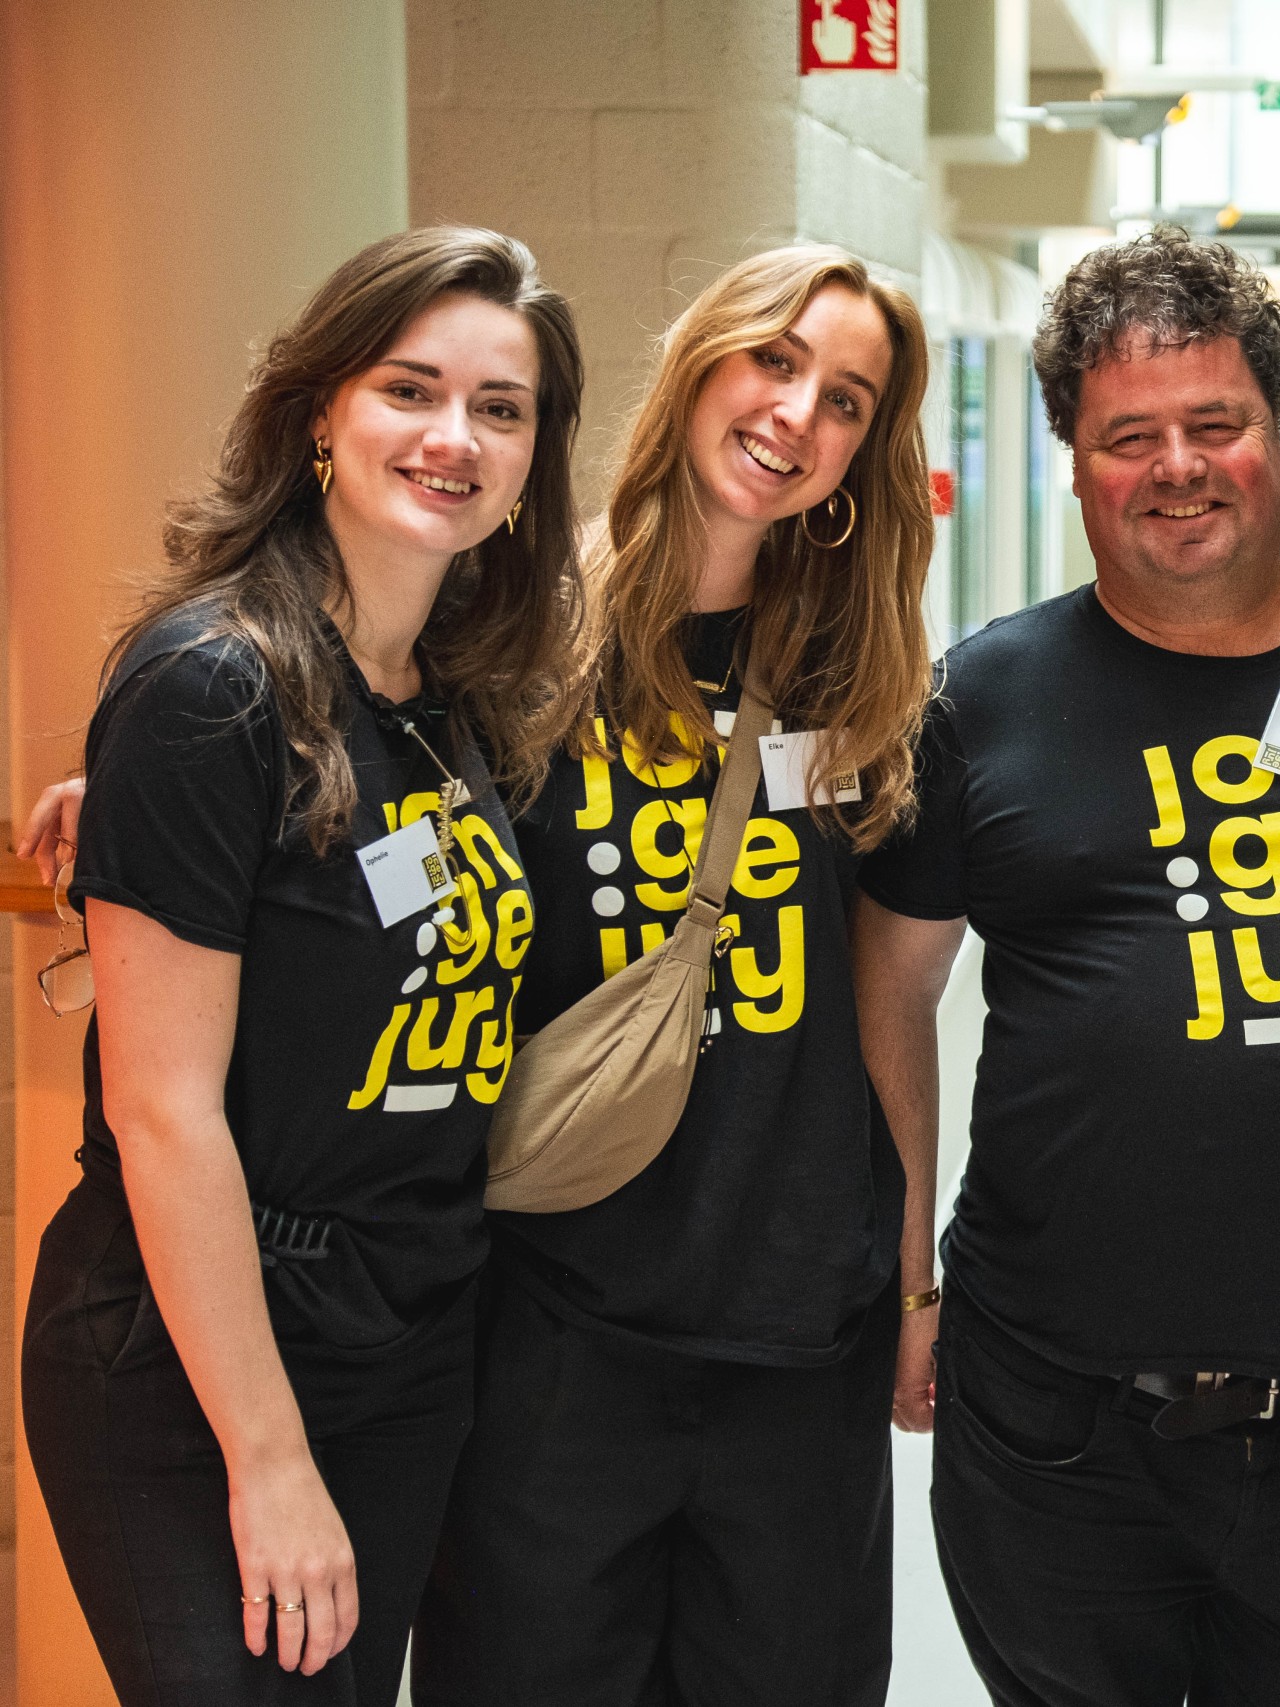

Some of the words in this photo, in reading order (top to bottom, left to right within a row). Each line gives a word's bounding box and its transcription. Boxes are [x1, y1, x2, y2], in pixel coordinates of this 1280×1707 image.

[575, 711, 730, 830] jo
[365, 851, 388, 866] Ophelie
[631, 798, 799, 911] ge
[347, 976, 523, 1110] jury
